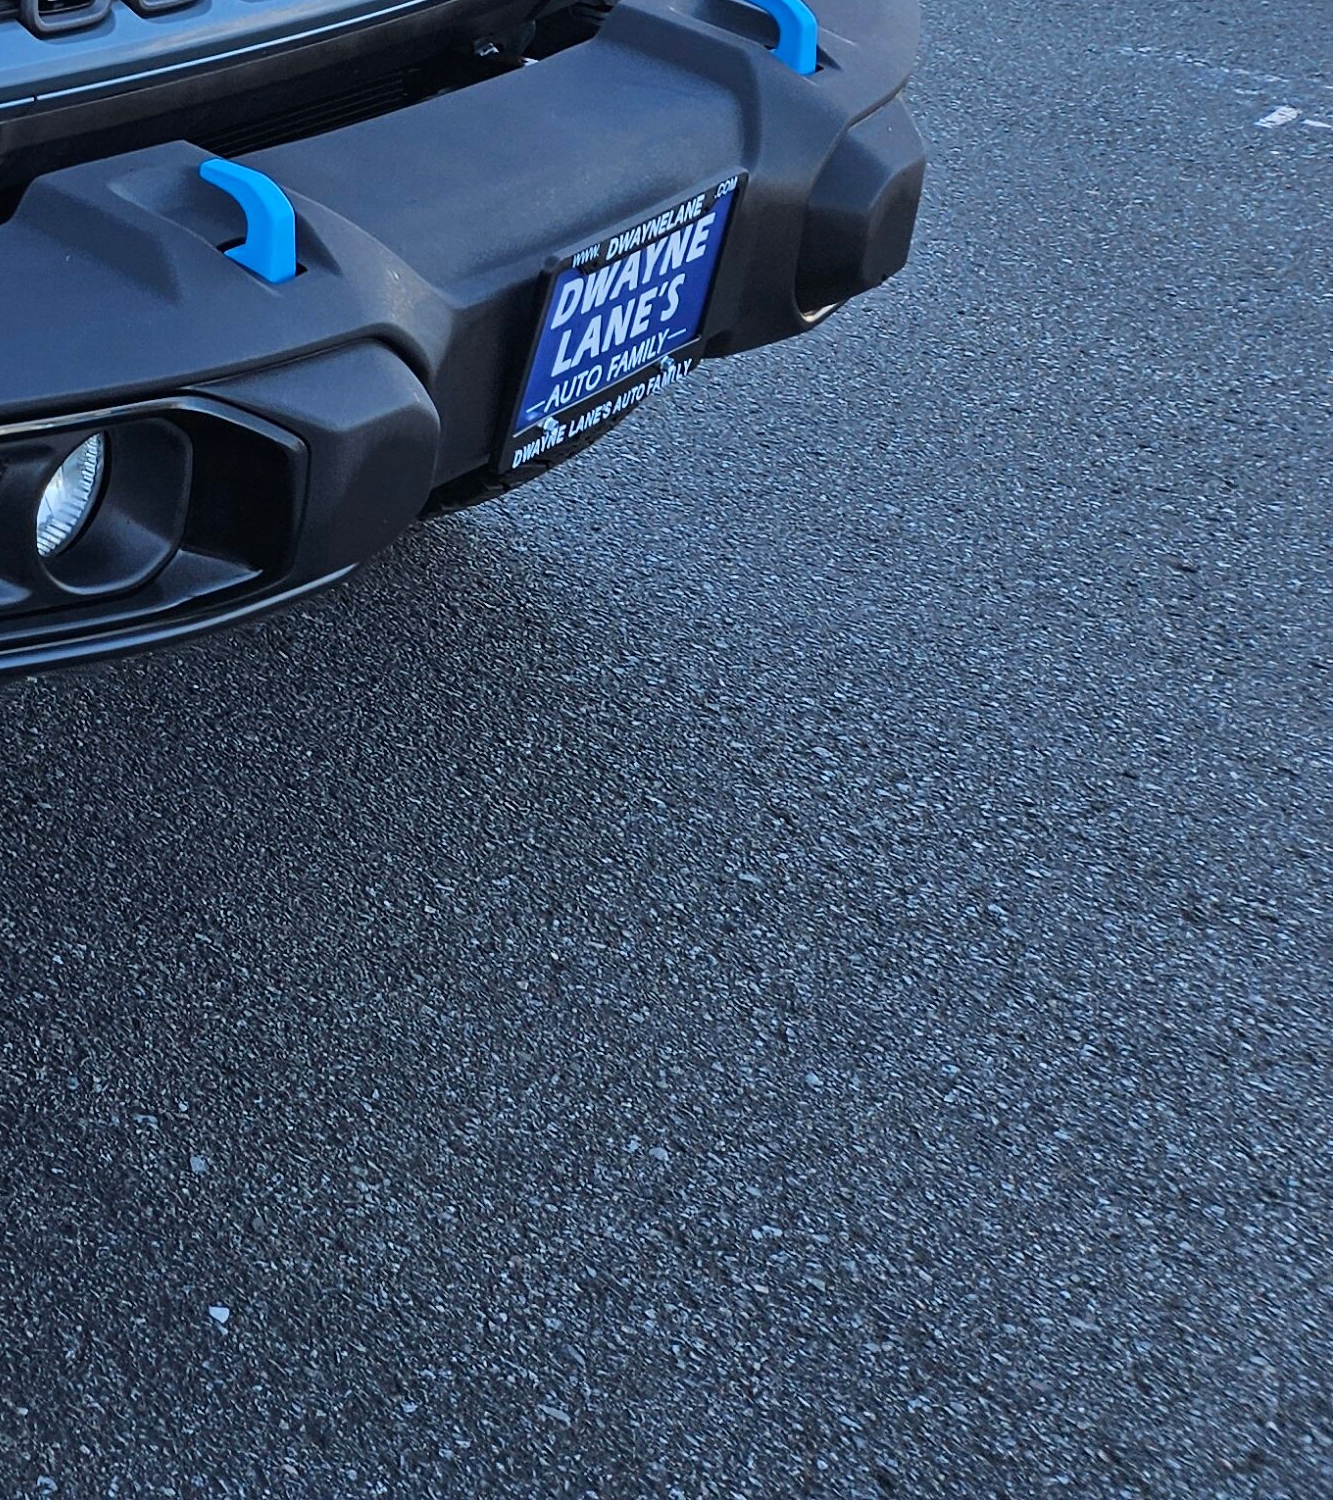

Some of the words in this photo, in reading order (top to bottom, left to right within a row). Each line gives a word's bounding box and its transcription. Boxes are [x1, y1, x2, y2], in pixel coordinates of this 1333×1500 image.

[550, 211, 715, 331] DWAYNE
[605, 194, 705, 261] DWAYNELANE
[544, 364, 602, 413] AUTO
[606, 326, 671, 382] FAMILY
[550, 272, 687, 378] LANE'S
[511, 424, 567, 469] DWAYNE
[567, 401, 613, 438] LANE'S
[612, 383, 645, 415] AUTO
[646, 358, 692, 396] FAMILY
